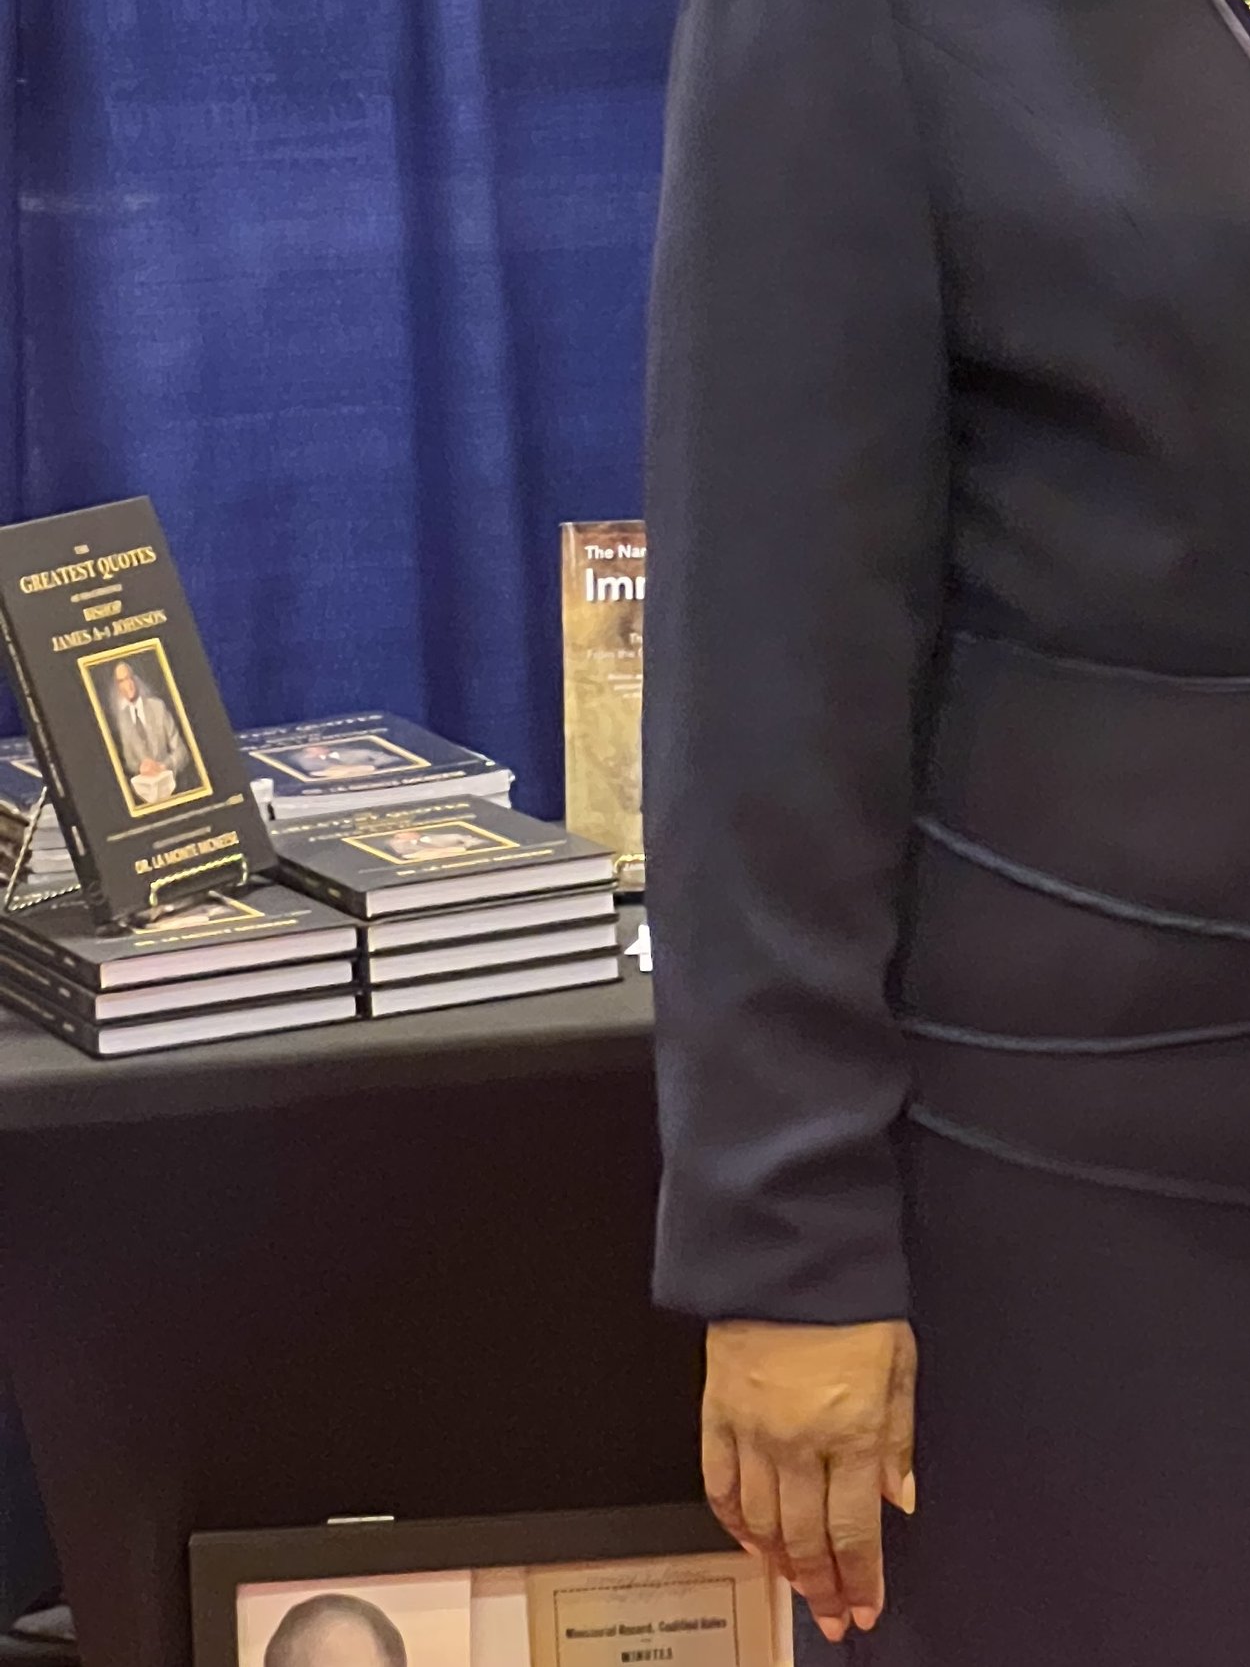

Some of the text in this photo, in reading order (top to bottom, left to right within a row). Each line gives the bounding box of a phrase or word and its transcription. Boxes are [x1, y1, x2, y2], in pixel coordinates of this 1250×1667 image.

[585, 544, 615, 560] The
[20, 560, 96, 594] GREATEST
[97, 546, 157, 580] QUOTES
